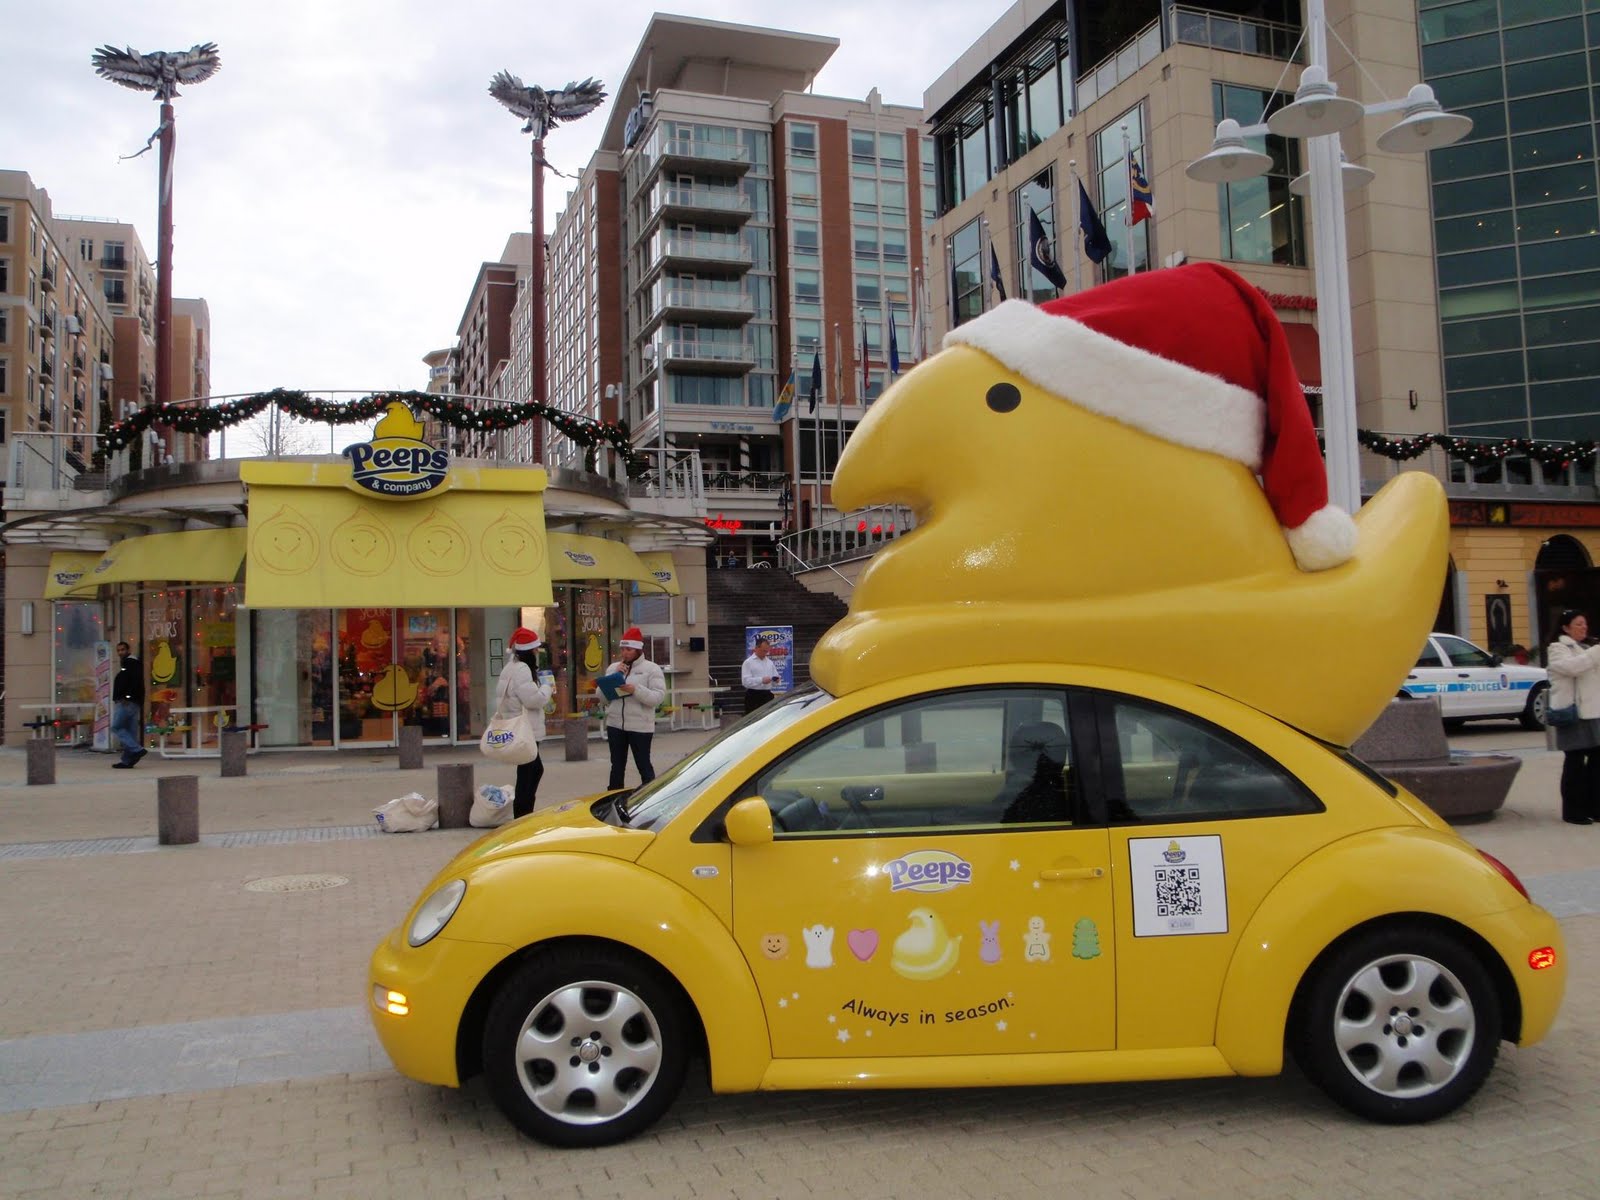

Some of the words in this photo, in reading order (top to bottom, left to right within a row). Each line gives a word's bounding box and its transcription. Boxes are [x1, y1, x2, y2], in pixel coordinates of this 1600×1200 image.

[342, 442, 449, 474] Peeps
[371, 479, 381, 490] &
[383, 479, 432, 494] company
[652, 571, 672, 582] eps
[1465, 683, 1499, 691] POLICE
[884, 859, 972, 885] Peeps
[842, 999, 909, 1027] Always
[919, 1010, 936, 1024] in
[945, 997, 1015, 1023] season.
